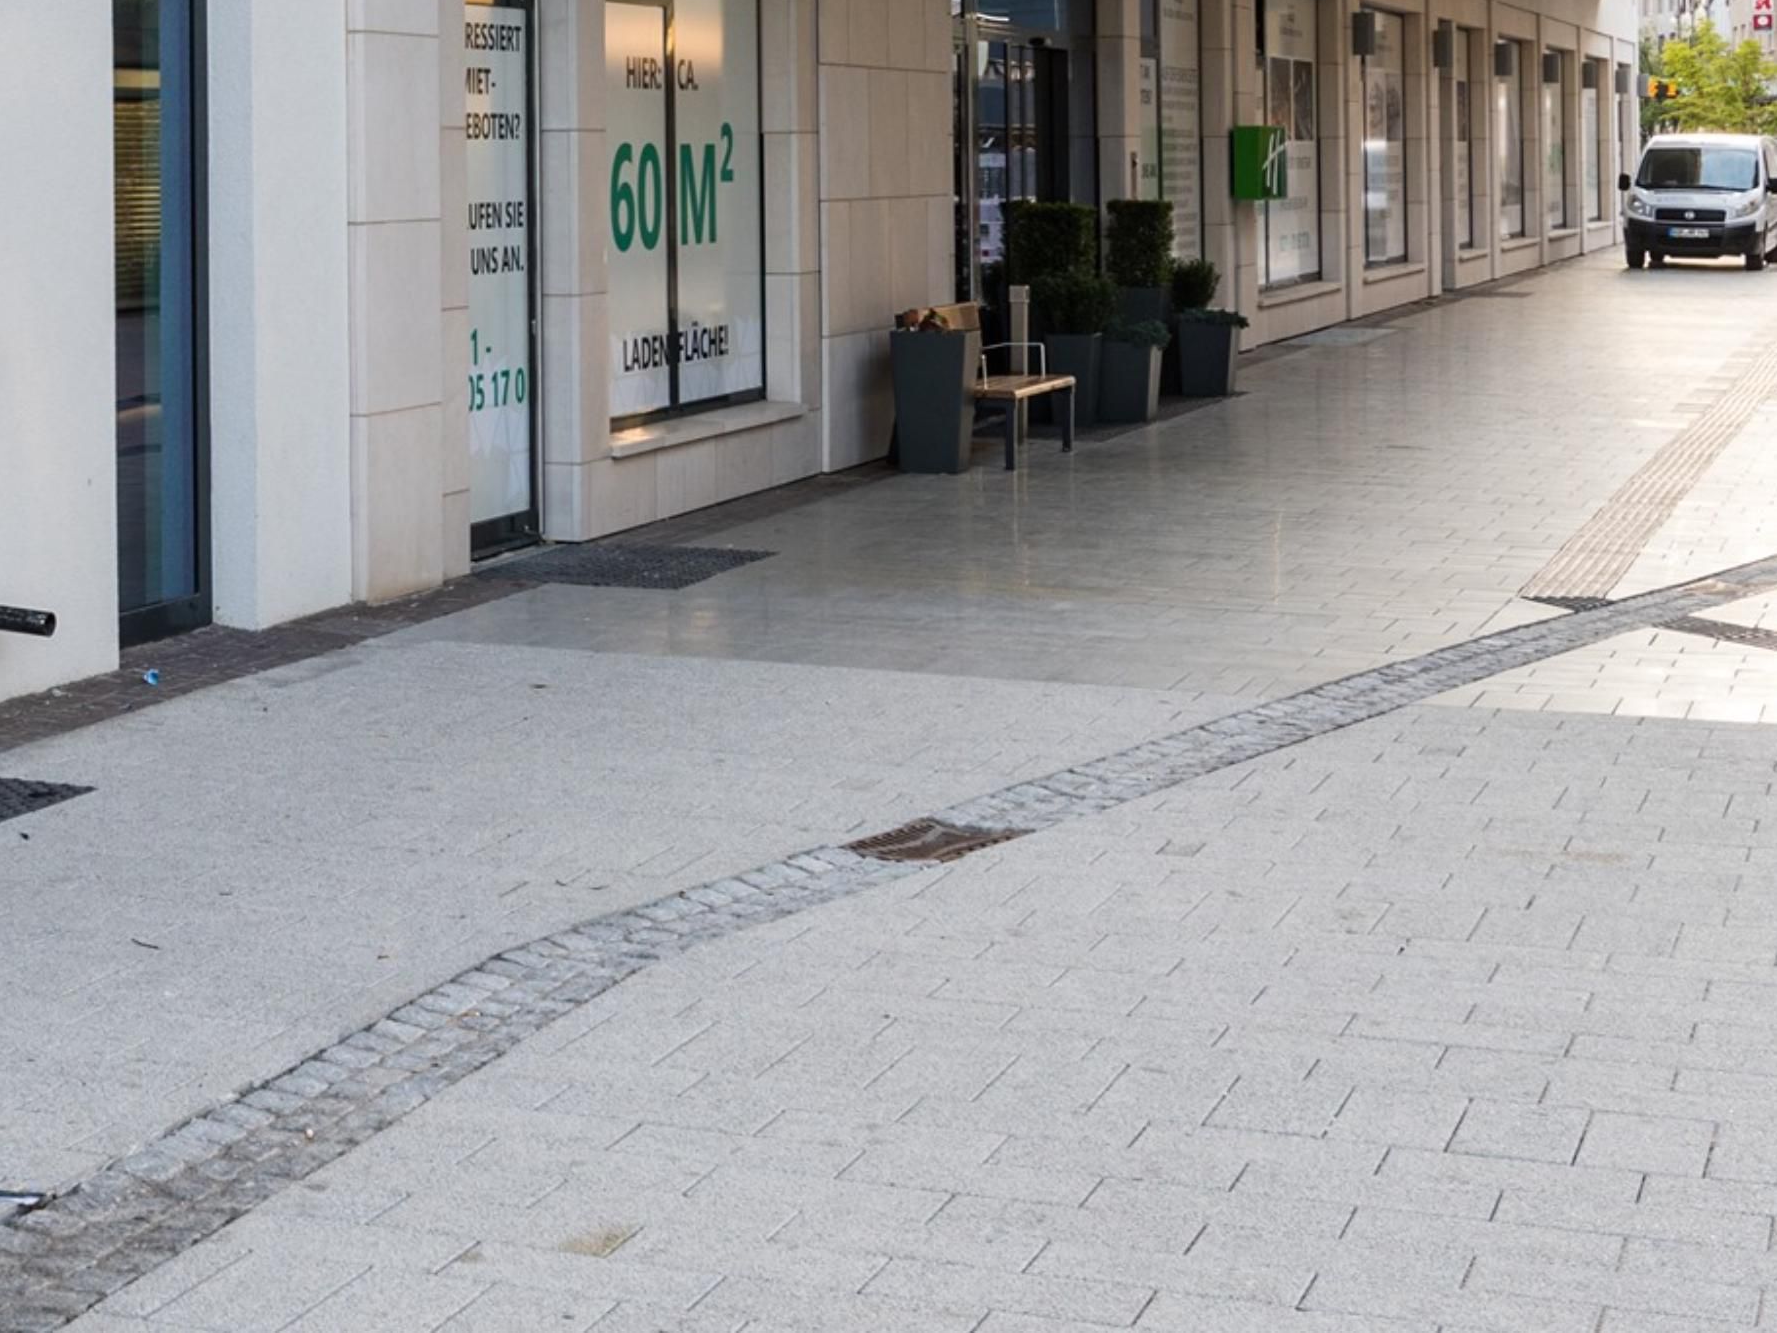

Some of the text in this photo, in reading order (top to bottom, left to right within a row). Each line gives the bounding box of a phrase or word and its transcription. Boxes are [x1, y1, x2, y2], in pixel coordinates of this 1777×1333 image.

[626, 56, 699, 91] HIER: CA.
[611, 142, 662, 253] 60
[467, 201, 524, 230] UFEN SIE
[470, 245, 524, 275] UNS AN.
